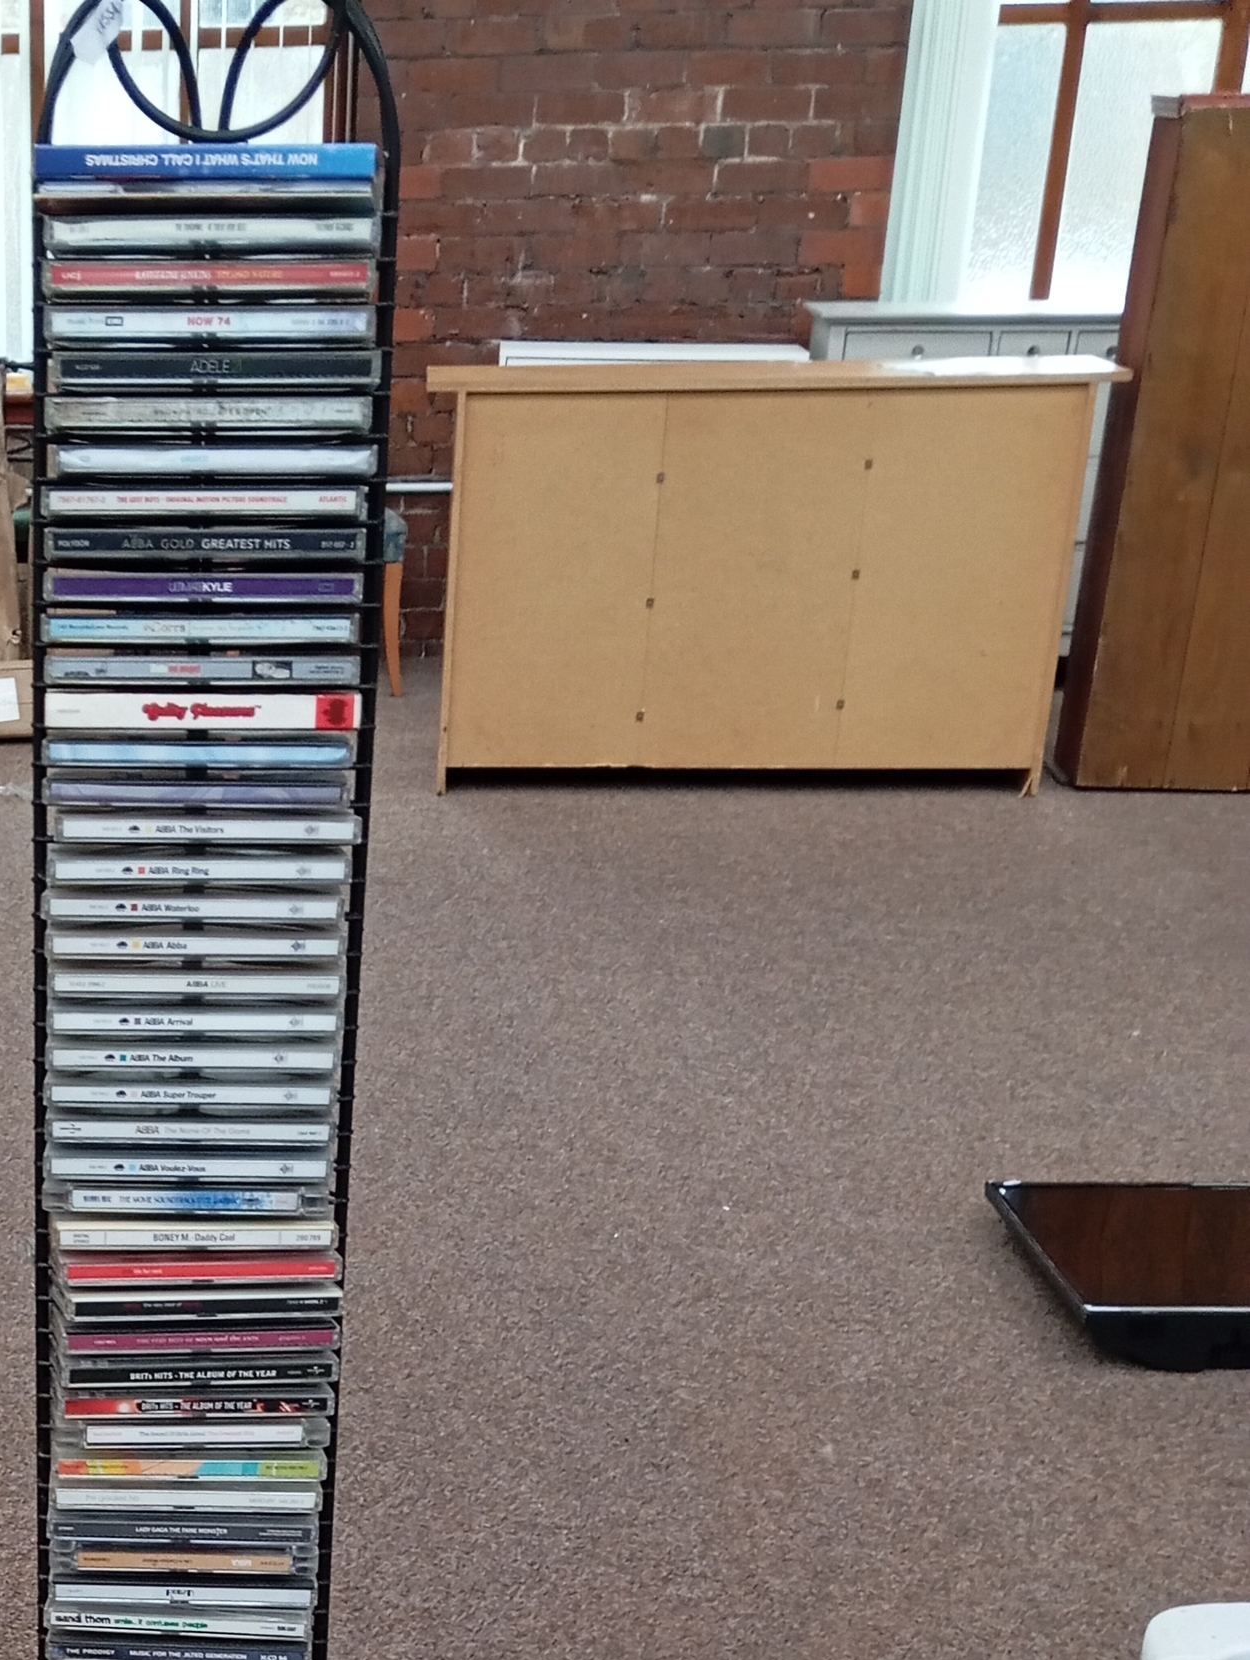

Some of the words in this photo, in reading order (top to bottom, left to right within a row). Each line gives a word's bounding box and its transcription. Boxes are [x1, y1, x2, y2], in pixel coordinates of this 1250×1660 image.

[85, 153, 159, 166] CHRISTMAS
[162, 153, 193, 166] CALL
[202, 153, 239, 166] WHAT
[286, 153, 318, 166] NOW
[187, 316, 214, 326] NOW
[190, 359, 231, 374] ADELE
[160, 538, 195, 549] GOLD
[201, 538, 262, 550] GREATEST
[263, 538, 292, 550] HITS
[171, 866, 190, 876] Ring
[191, 866, 210, 876] Ring
[164, 903, 200, 912] Waterloo
[166, 1016, 193, 1026] Arrival
[152, 1054, 168, 1063] The
[168, 1054, 194, 1063] Album
[162, 1090, 186, 1100] Super
[187, 1090, 217, 1100] Trouper
[152, 1233, 179, 1242] BONEY
[194, 1233, 218, 1244] Daddy
[219, 1233, 236, 1242] Cool
[154, 1371, 173, 1380] HITS
[179, 1371, 195, 1379] THE
[196, 1370, 225, 1379] ALBUM
[226, 1370, 237, 1378] OF
[238, 1370, 255, 1378] THE
[256, 1369, 277, 1378] YEAR
[180, 1401, 192, 1411] THE
[192, 1401, 214, 1410] ALBUM
[214, 1401, 223, 1410] OF
[224, 1401, 236, 1410] THE
[236, 1401, 253, 1410] YEAR
[84, 1614, 111, 1624] thom
[181, 1621, 209, 1630] people
[81, 1648, 116, 1656] PRODIGY
[168, 1651, 182, 1659] THE
[205, 1652, 248, 1660] GENERATION
